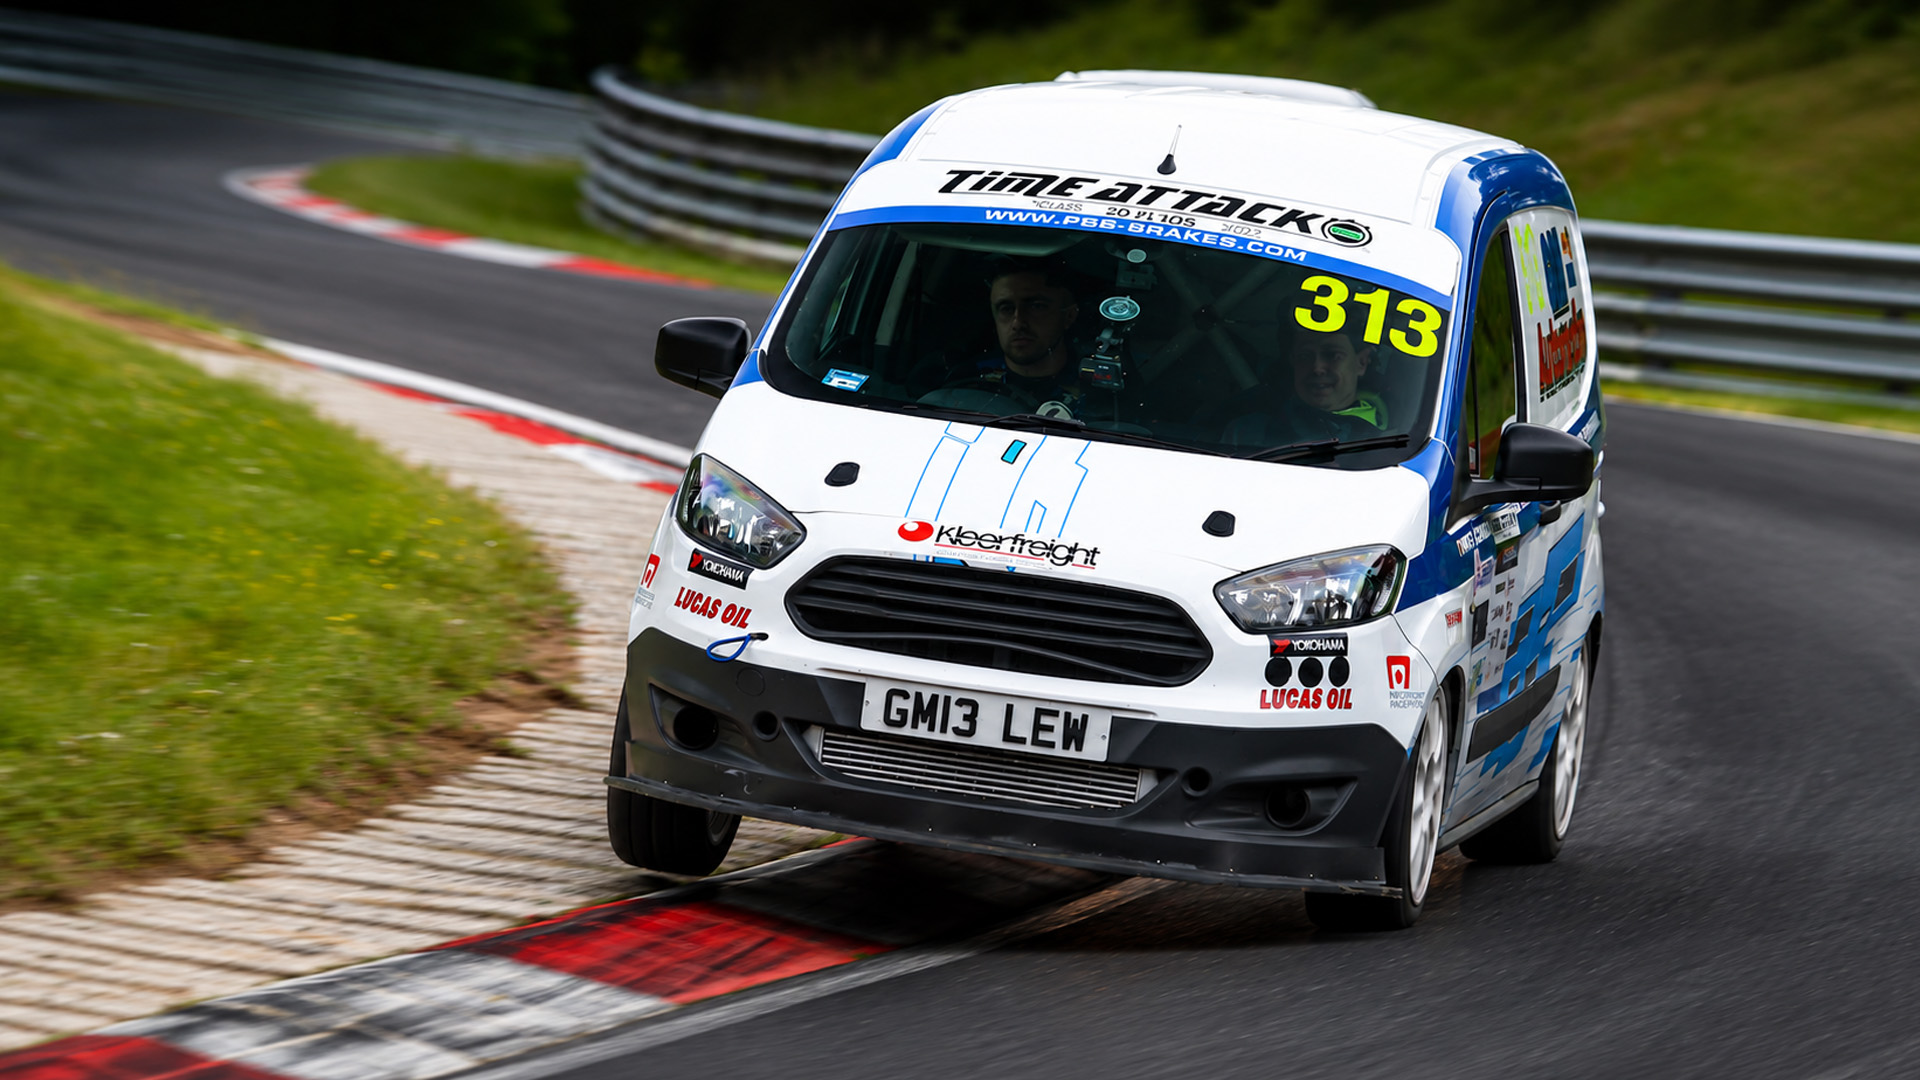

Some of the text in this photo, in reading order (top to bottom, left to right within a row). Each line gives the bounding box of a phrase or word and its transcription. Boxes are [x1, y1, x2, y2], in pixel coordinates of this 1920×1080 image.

[1085, 182, 1324, 234] ATTACK
[1294, 275, 1443, 358] 313
[935, 525, 1101, 566] Kleerfreight
[674, 587, 722, 619] LUCAS
[721, 603, 752, 629] OIL
[1291, 639, 1345, 651] YOKOHAMA
[1260, 688, 1353, 709] LUCAS OIL
[883, 688, 1089, 752] GM13 LEW
